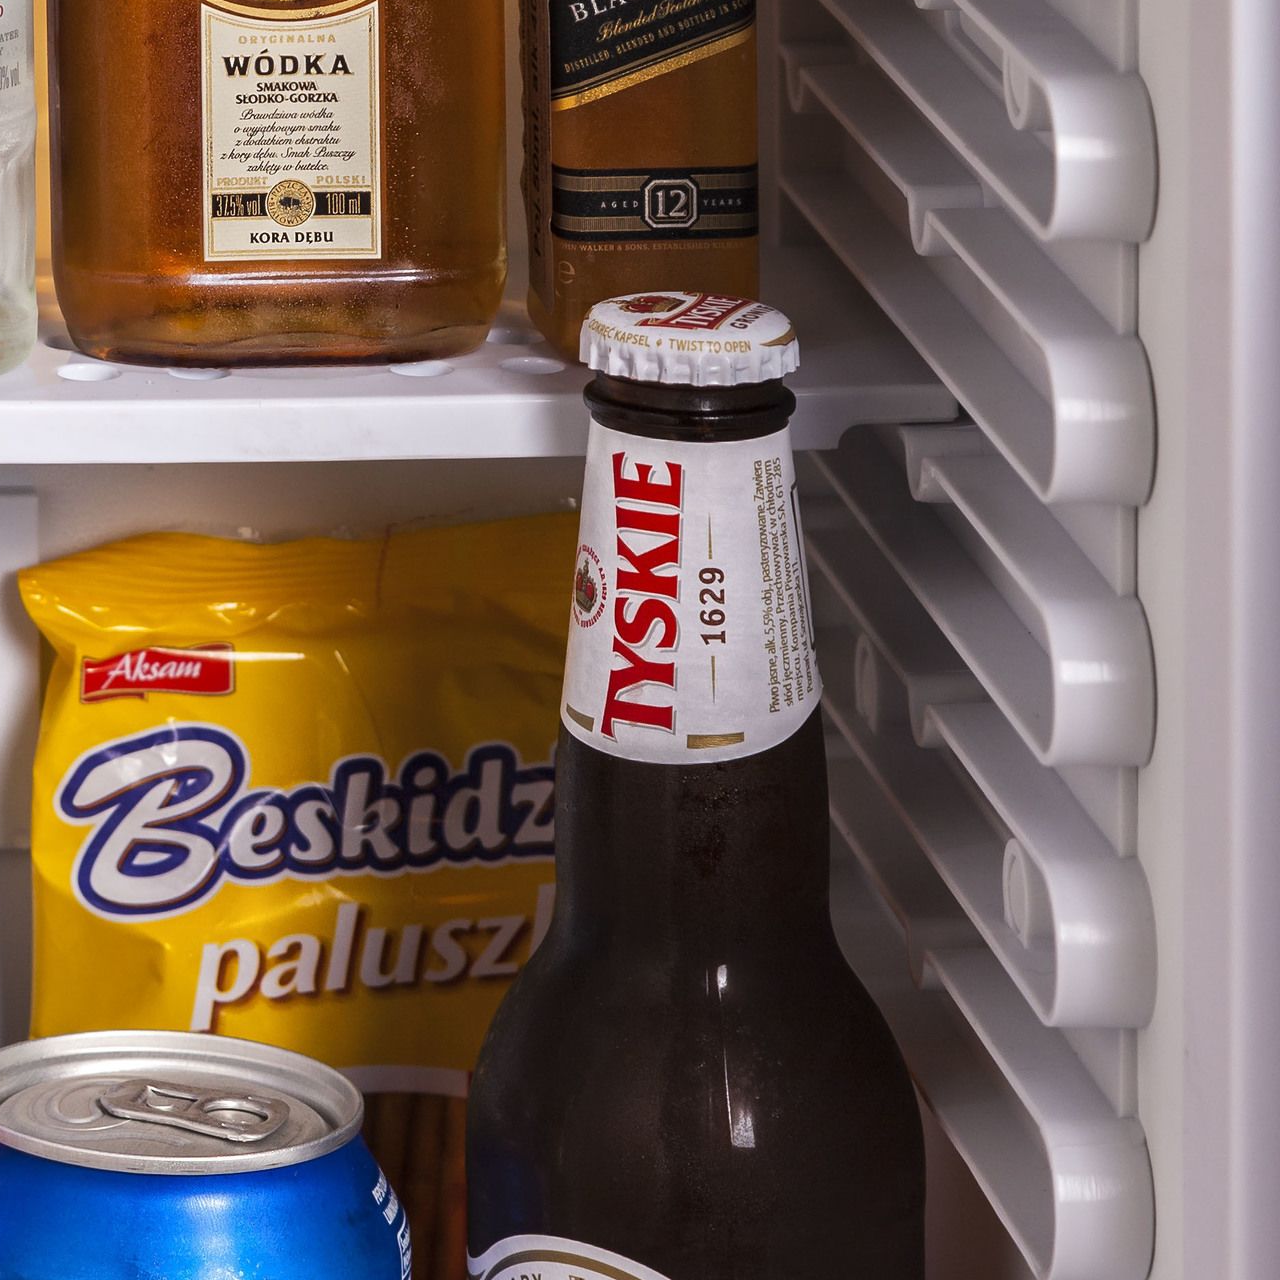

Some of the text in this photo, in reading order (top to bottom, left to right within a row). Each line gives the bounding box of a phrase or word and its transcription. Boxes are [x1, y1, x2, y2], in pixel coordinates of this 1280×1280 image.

[596, 4, 660, 43] Blended
[238, 34, 337, 45] ORYGINALNA
[222, 49, 353, 76] WÓDKA
[256, 81, 318, 93] SMAKOWA
[235, 93, 339, 105] SŁODKO-GORZKA
[239, 108, 334, 121] Prawdziwa wódka
[307, 124, 342, 132] smaku
[242, 134, 340, 146] dodatkiem ekstraktu
[280, 147, 312, 159] Smak
[316, 175, 367, 184] POLSKI
[326, 193, 361, 215] 100 ml
[600, 189, 743, 218] AGED 12 YEARS
[250, 231, 334, 245] KORA DĘBU
[670, 296, 743, 326] TYSKIE
[614, 331, 650, 348] KAPSEL
[669, 338, 751, 353] TWIST TO OPEN
[601, 451, 686, 741] TYSKIE
[700, 567, 726, 646] 1629
[102, 650, 201, 688] Aksam
[54, 721, 556, 923] Beskidz
